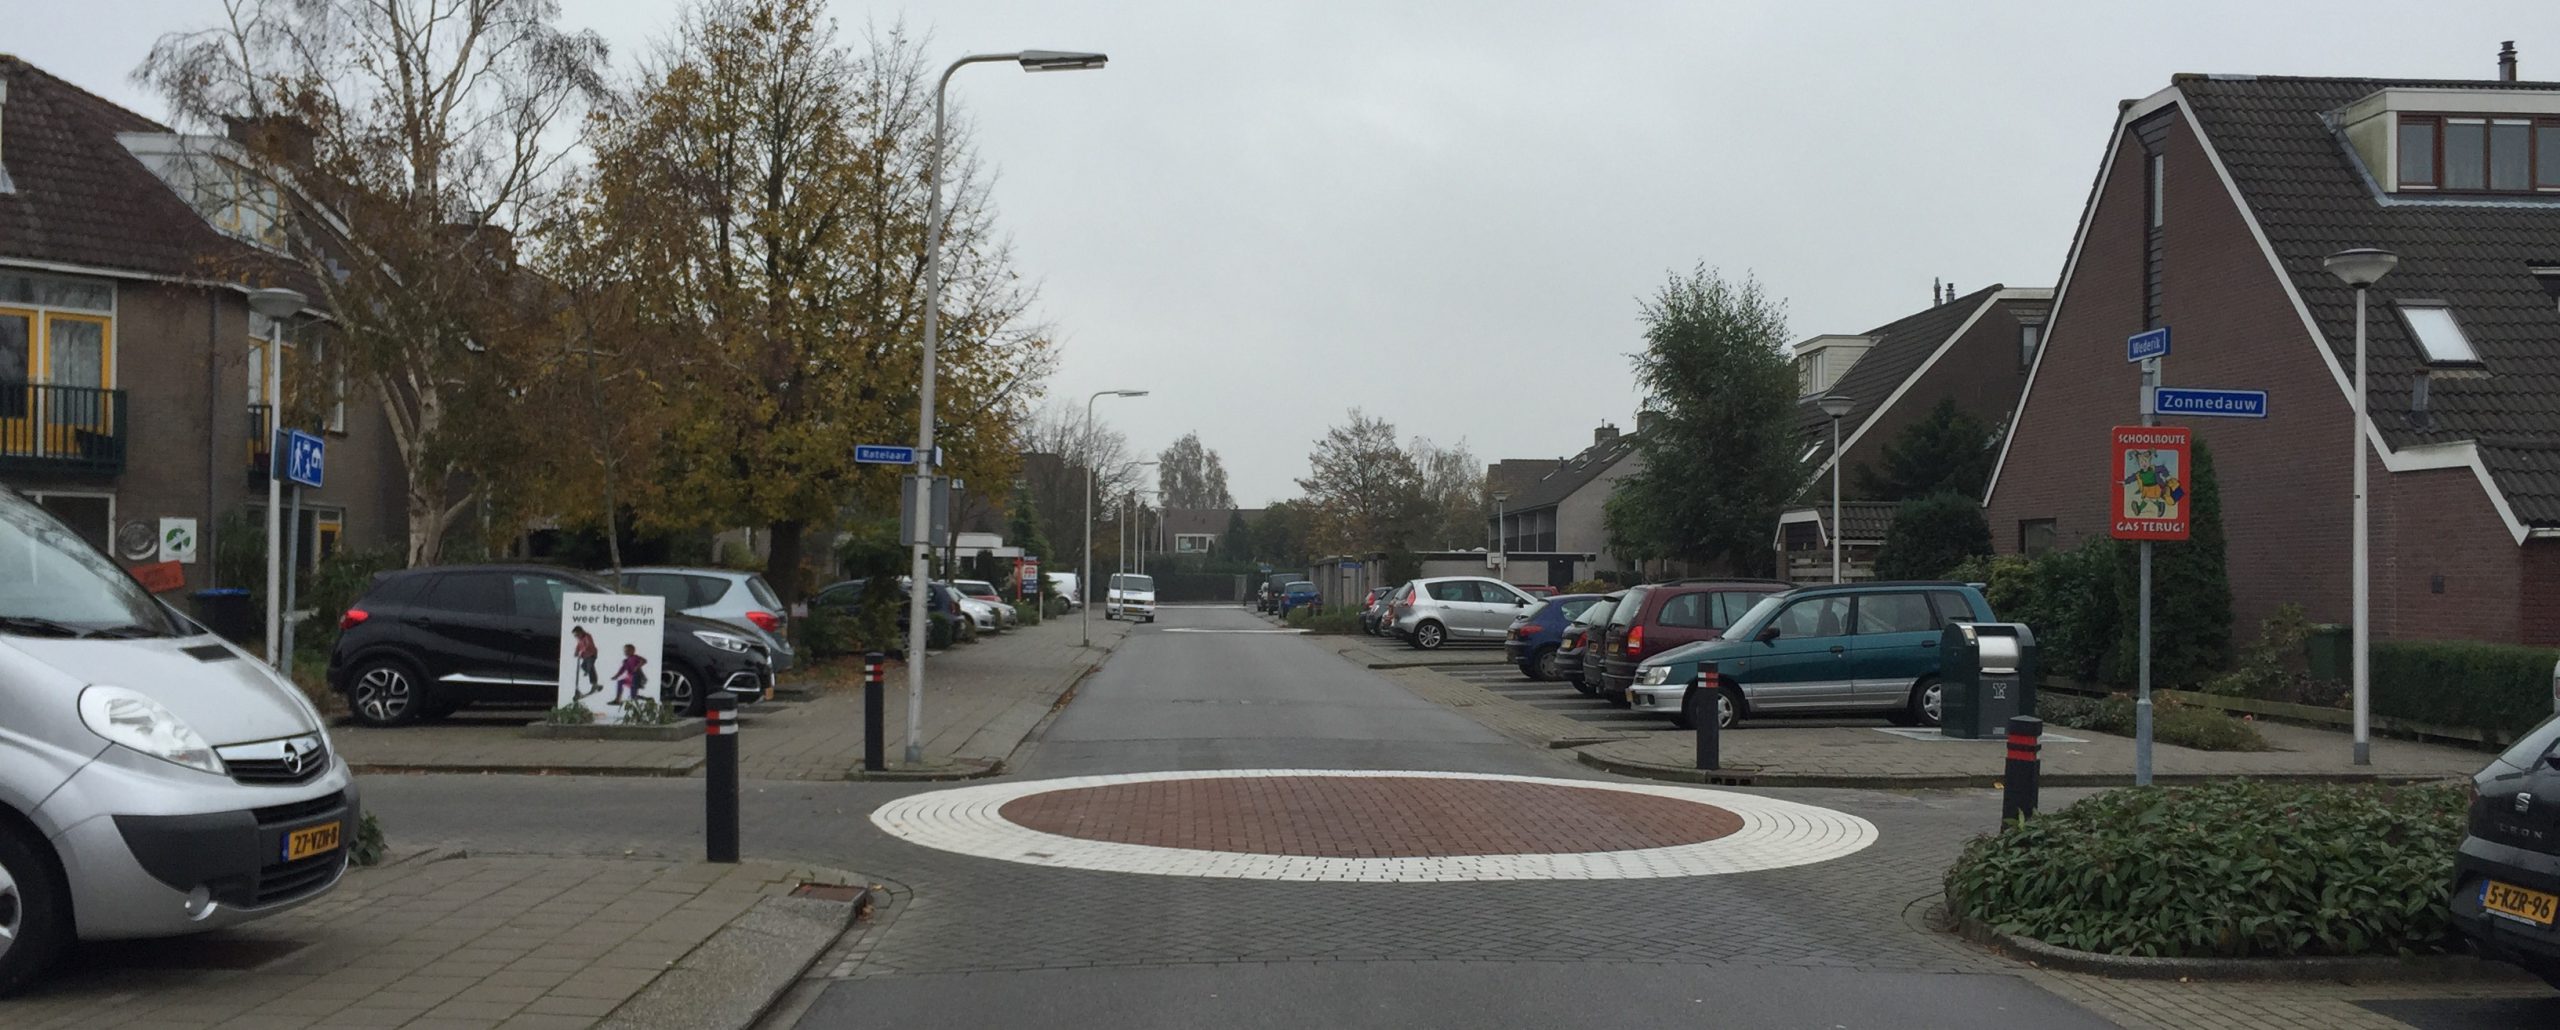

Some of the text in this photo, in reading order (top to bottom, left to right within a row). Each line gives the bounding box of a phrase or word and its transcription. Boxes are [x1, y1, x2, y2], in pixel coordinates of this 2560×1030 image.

[2132, 337, 2161, 355] Wederik
[2164, 394, 2258, 411] Zonnedauw
[2118, 434, 2186, 445] SCHOOLROUTE
[862, 449, 907, 460] Ratelaar
[2116, 521, 2185, 533] GAS TERUG!
[573, 601, 654, 617] De scholen zijn
[572, 614, 656, 627] weer begonnen
[2488, 885, 2552, 919] 5-KZR-96
